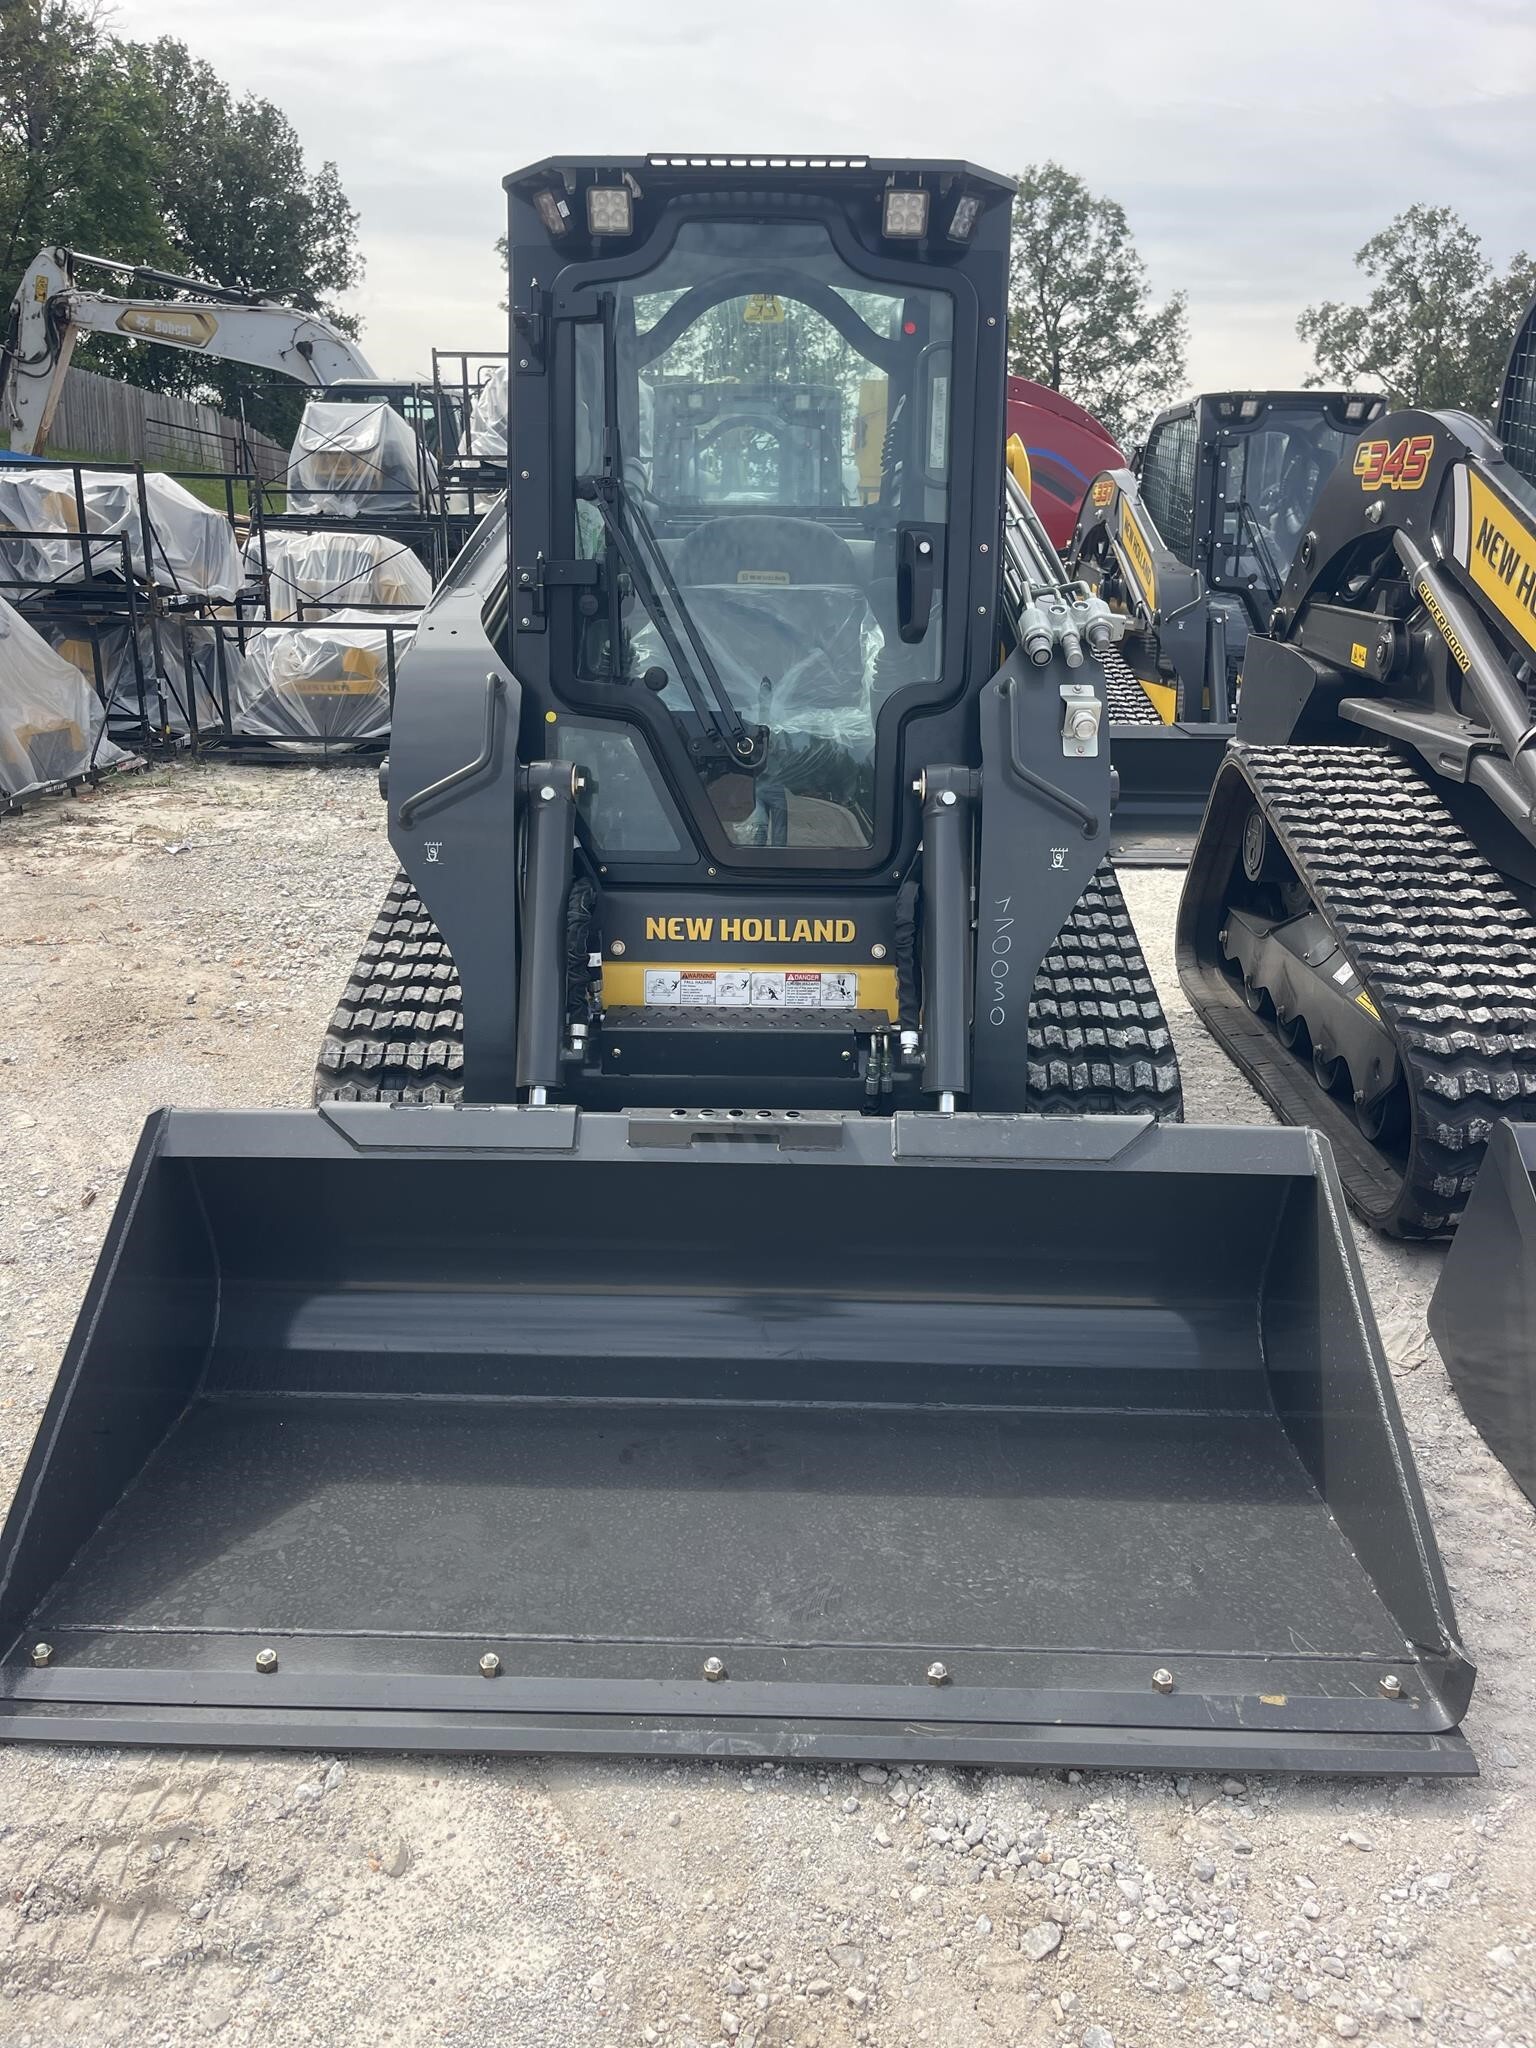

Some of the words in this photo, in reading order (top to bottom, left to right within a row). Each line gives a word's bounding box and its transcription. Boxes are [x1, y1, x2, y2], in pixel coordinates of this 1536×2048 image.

[155, 319, 192, 336] Bobcat
[1475, 516, 1521, 586] NEW
[1418, 582, 1447, 630] SUPER
[1442, 626, 1471, 671] BOOM
[646, 917, 713, 941] NEW
[720, 918, 856, 943] HOLLAND
